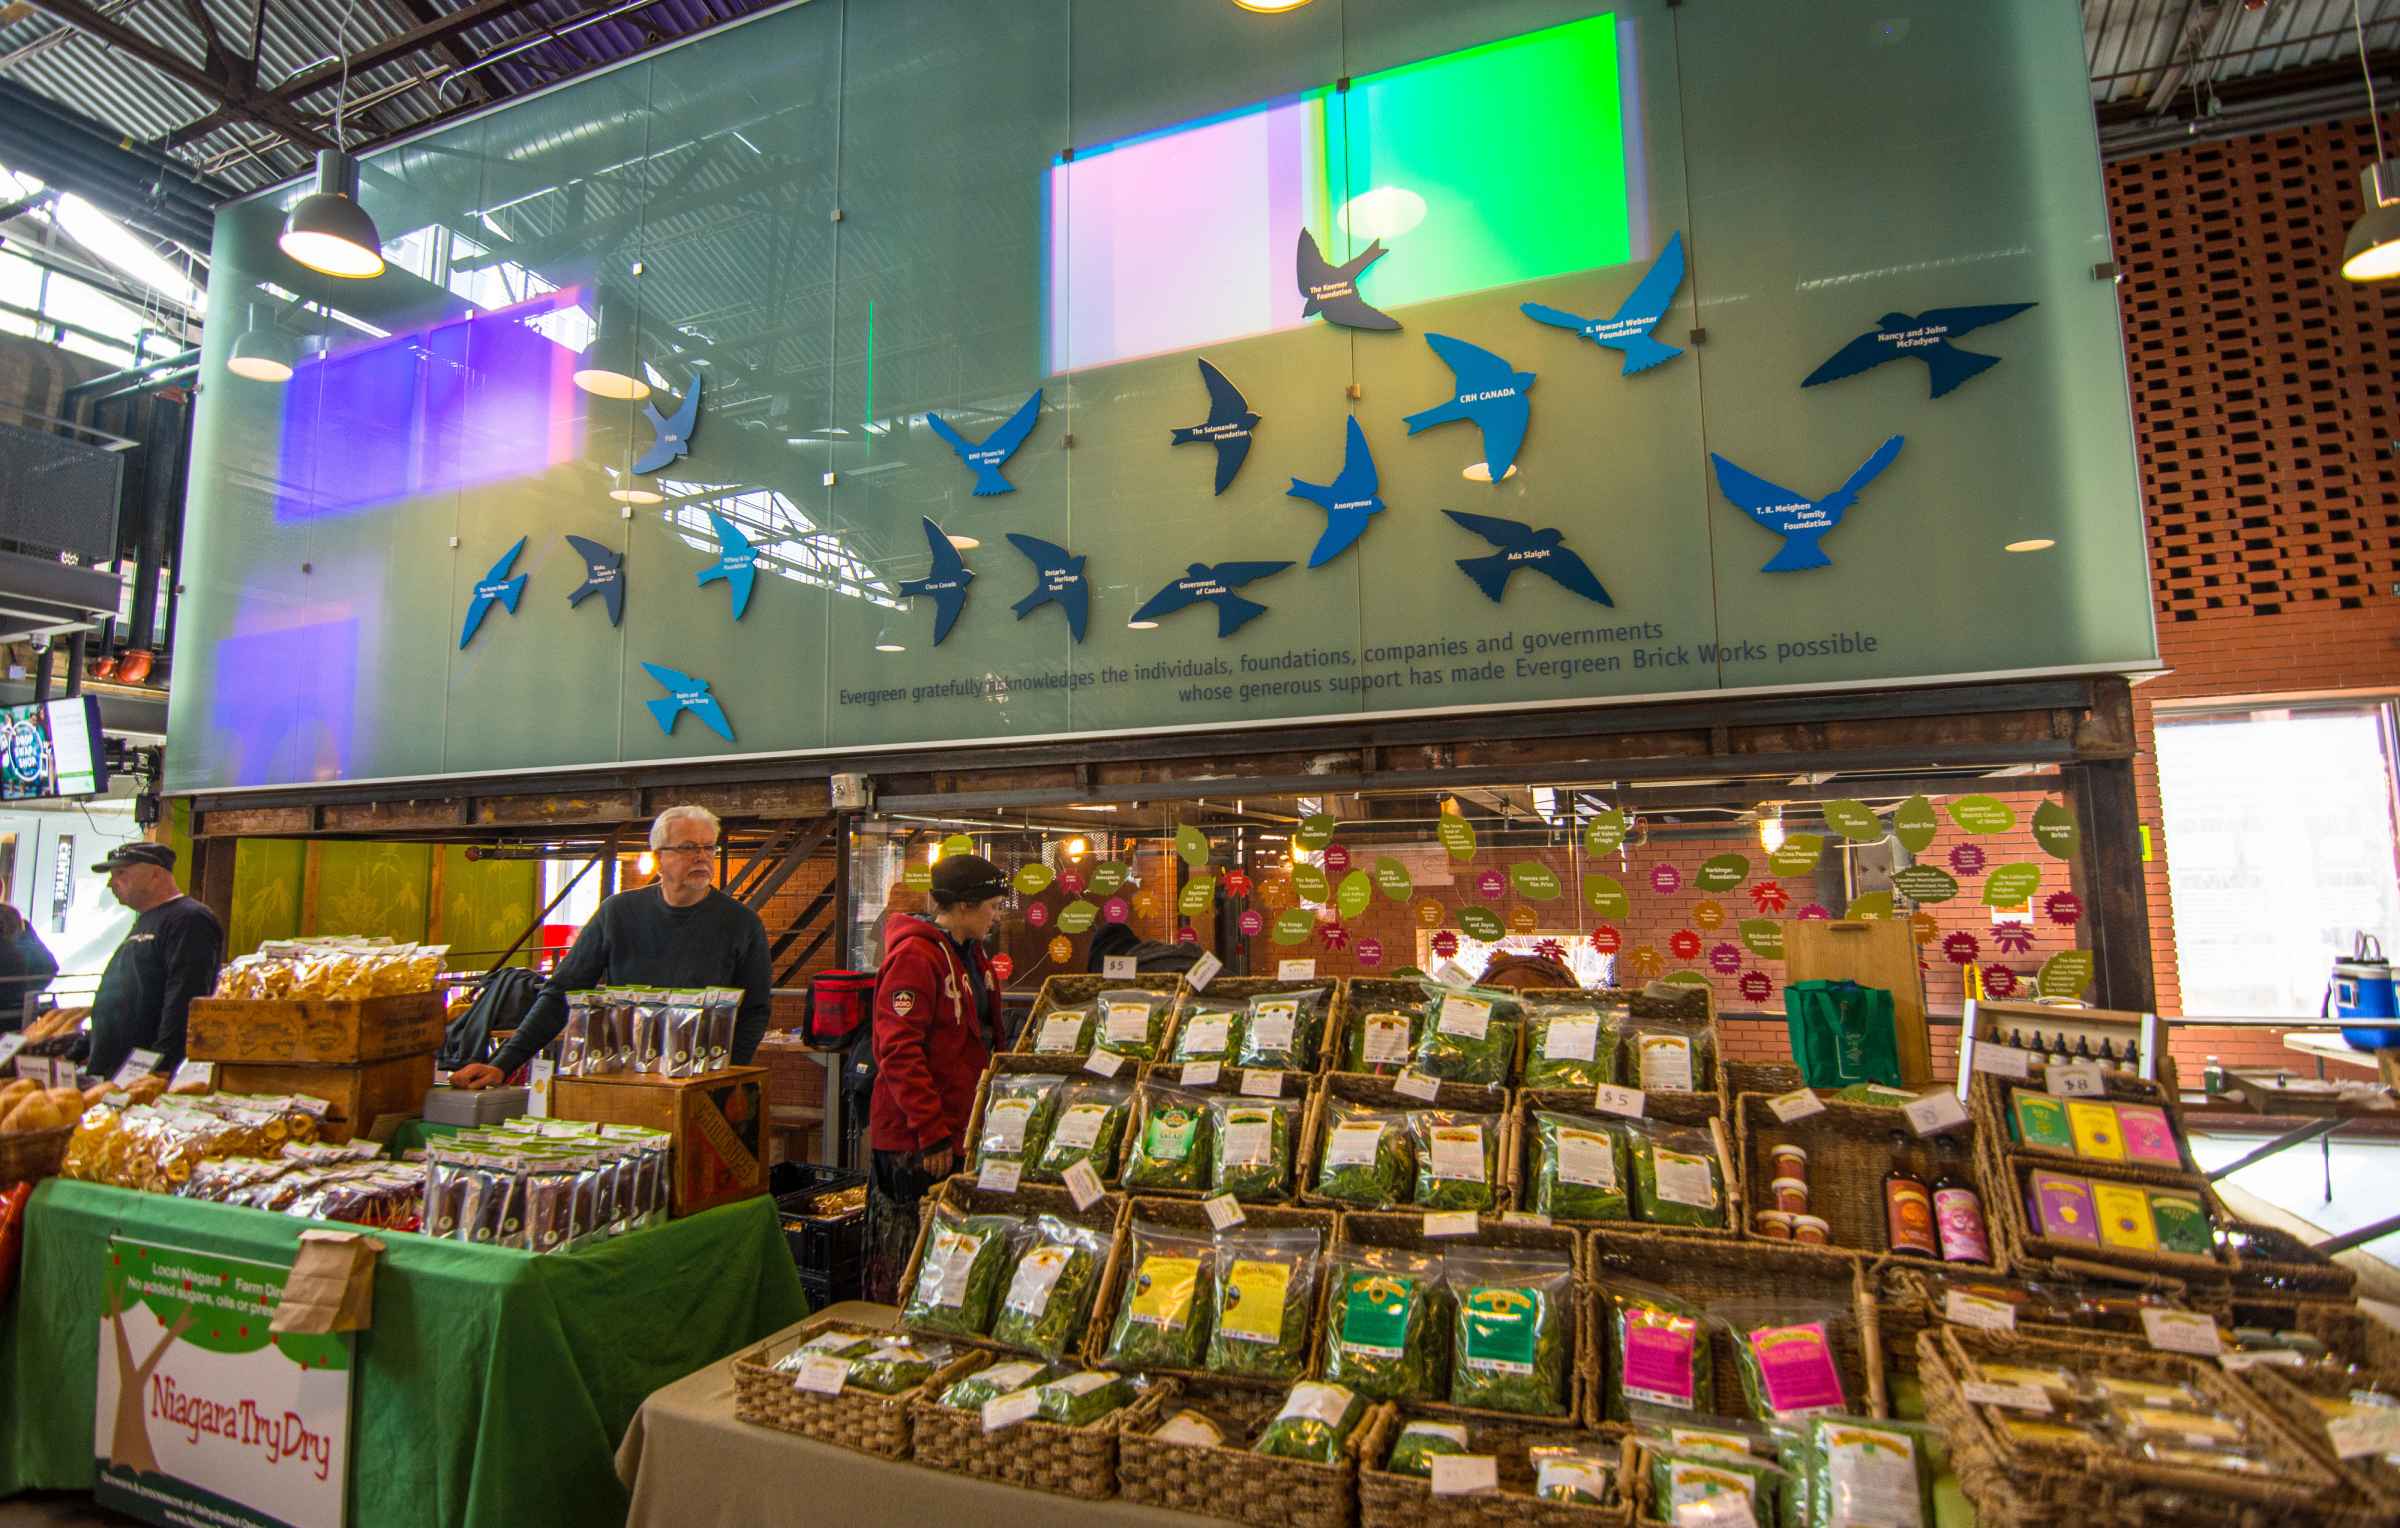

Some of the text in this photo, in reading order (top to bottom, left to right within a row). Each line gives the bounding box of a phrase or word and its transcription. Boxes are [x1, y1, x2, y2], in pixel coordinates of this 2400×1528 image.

[1317, 288, 1353, 300] Foundation
[1596, 321, 1624, 332] Howard
[1626, 316, 1657, 328] Webster
[1600, 326, 1642, 340] Foundation
[1878, 324, 1949, 345] Nancy and John
[1897, 335, 1941, 349] McFadyen
[1460, 387, 1516, 404] CRH CANADA
[1192, 423, 1239, 437] The Salamander
[1215, 430, 1249, 441] Foundation
[1334, 499, 1372, 511] Anonymous
[1775, 502, 1811, 515] Meighen
[1797, 510, 1827, 523] Family
[1783, 518, 1833, 531] Foundation
[1507, 549, 1551, 562] Ada Slaight
[1044, 568, 1066, 577] Ontario
[1055, 574, 1079, 584] Heritage
[1048, 583, 1064, 591] Trust
[1179, 579, 1217, 591] Government
[1204, 586, 1227, 596] Canada
[839, 621, 1663, 705] Evergreen gratefully acknowledges the individuals, foundations, companies and governments
[1179, 630, 1878, 703] whose generous support has made Evergreen Brick Works possible
[2039, 823, 2071, 832] Brampton
[2051, 831, 2068, 839] Brick
[1861, 912, 1878, 920] CIBC
[152, 1261, 284, 1299] Local Niagara Farm Dir
[128, 1274, 143, 1290] No
[144, 1281, 176, 1298] added
[177, 1288, 215, 1308] sugars,
[216, 1295, 236, 1310] oils
[237, 1302, 249, 1312] or
